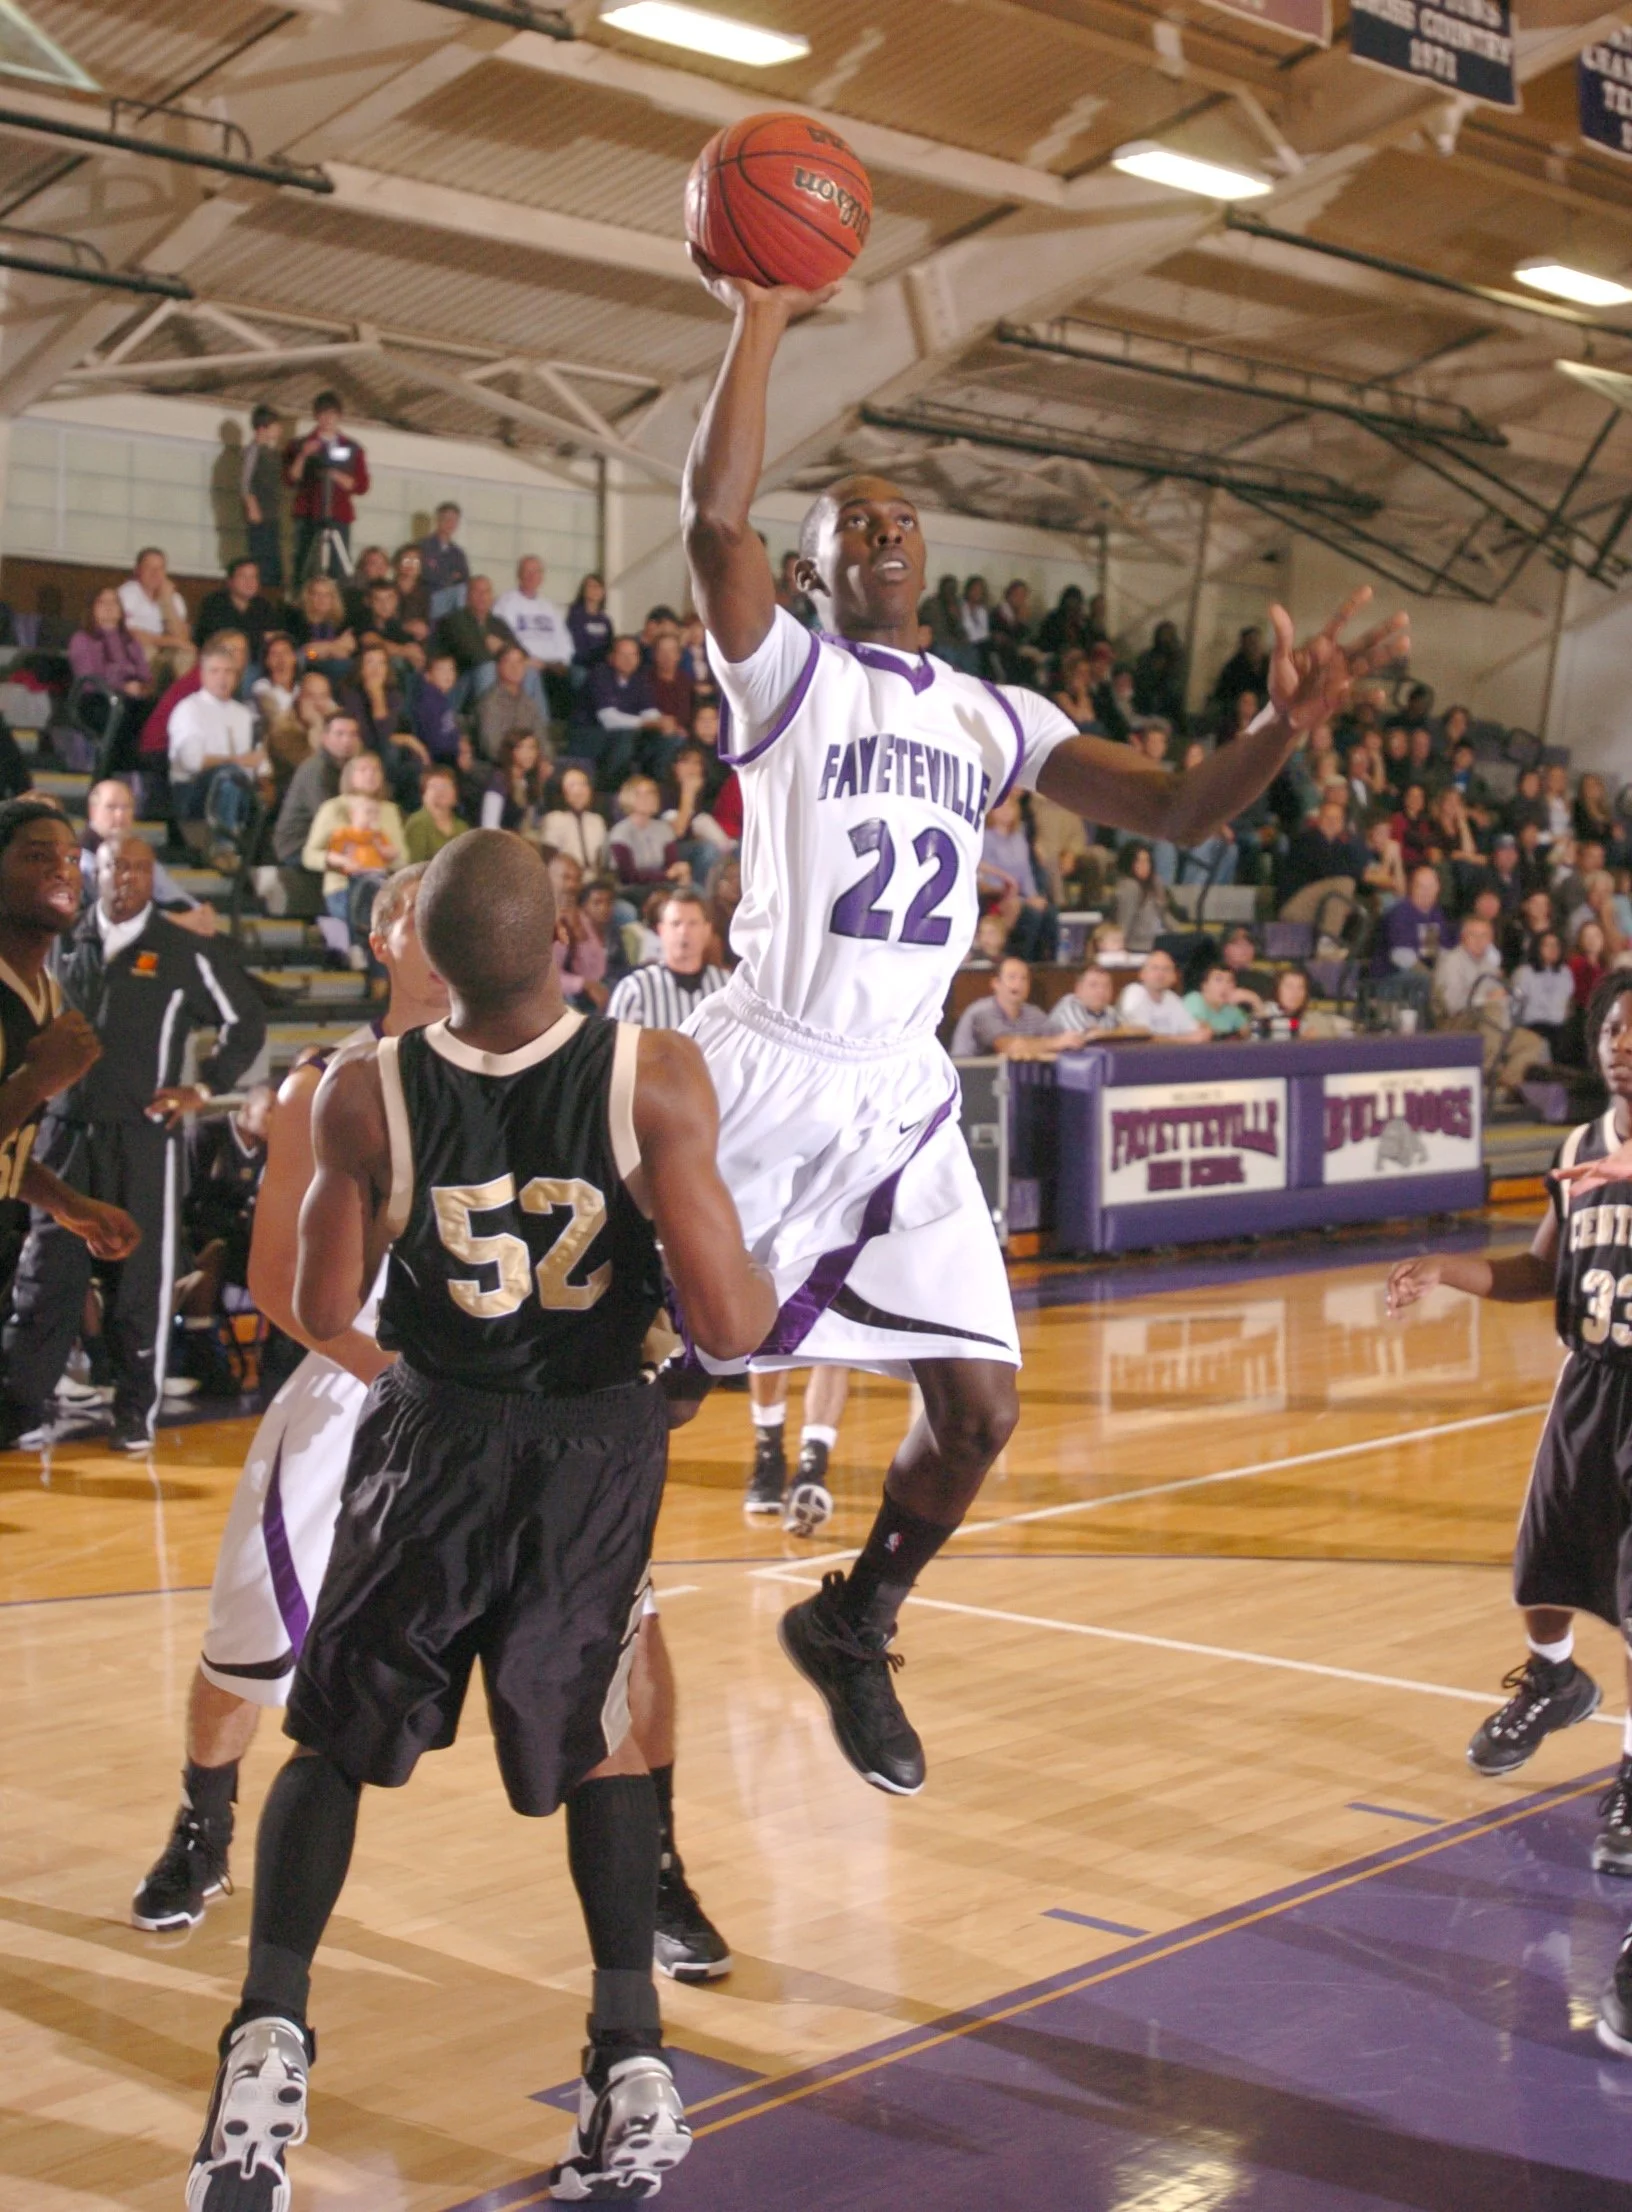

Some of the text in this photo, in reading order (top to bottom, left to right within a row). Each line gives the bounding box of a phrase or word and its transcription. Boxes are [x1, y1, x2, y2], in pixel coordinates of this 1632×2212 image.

[818, 733, 991, 833] FAYETEVILLE
[829, 817, 959, 946] 22
[431, 1172, 613, 1318] 52
[1571, 1205, 1632, 1252] CENT
